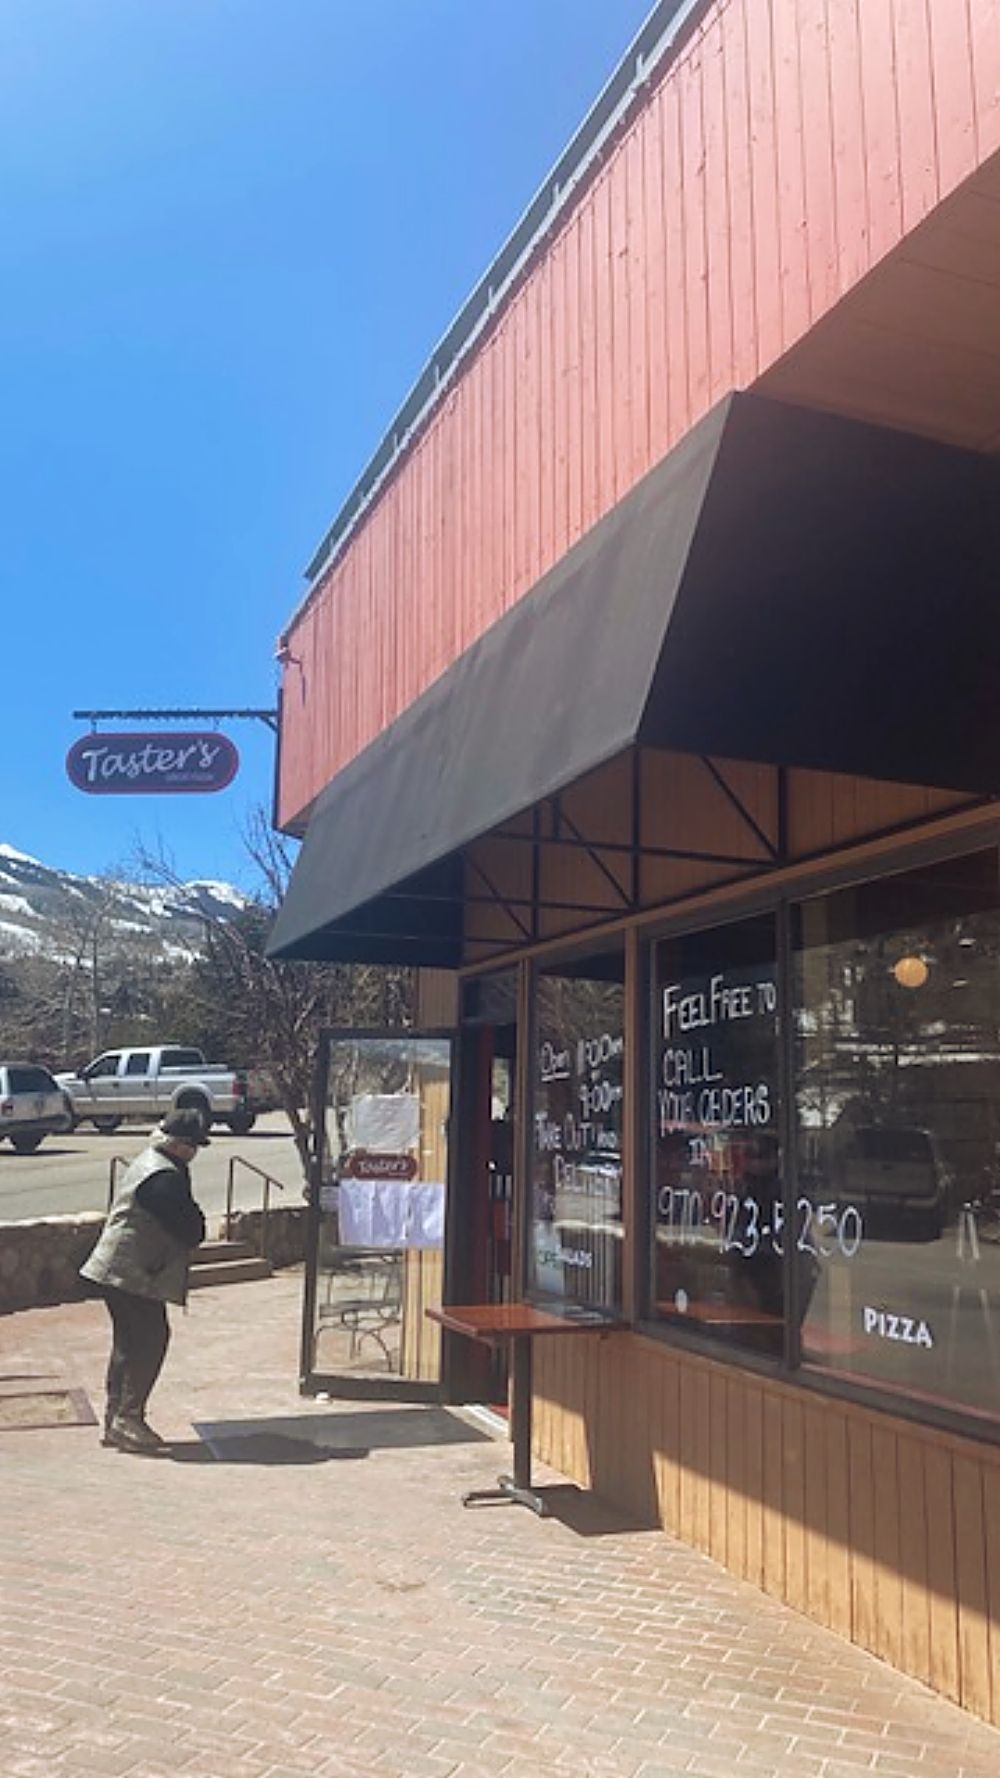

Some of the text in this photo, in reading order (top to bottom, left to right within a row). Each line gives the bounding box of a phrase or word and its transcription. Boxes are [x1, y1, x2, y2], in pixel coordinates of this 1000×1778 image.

[82, 740, 220, 782] Taster's
[664, 974, 777, 1040] FEEL FREE TO
[663, 1047, 724, 1087] CALL
[658, 1087, 694, 1137] YOUR
[863, 1306, 933, 1349] PIZZA
